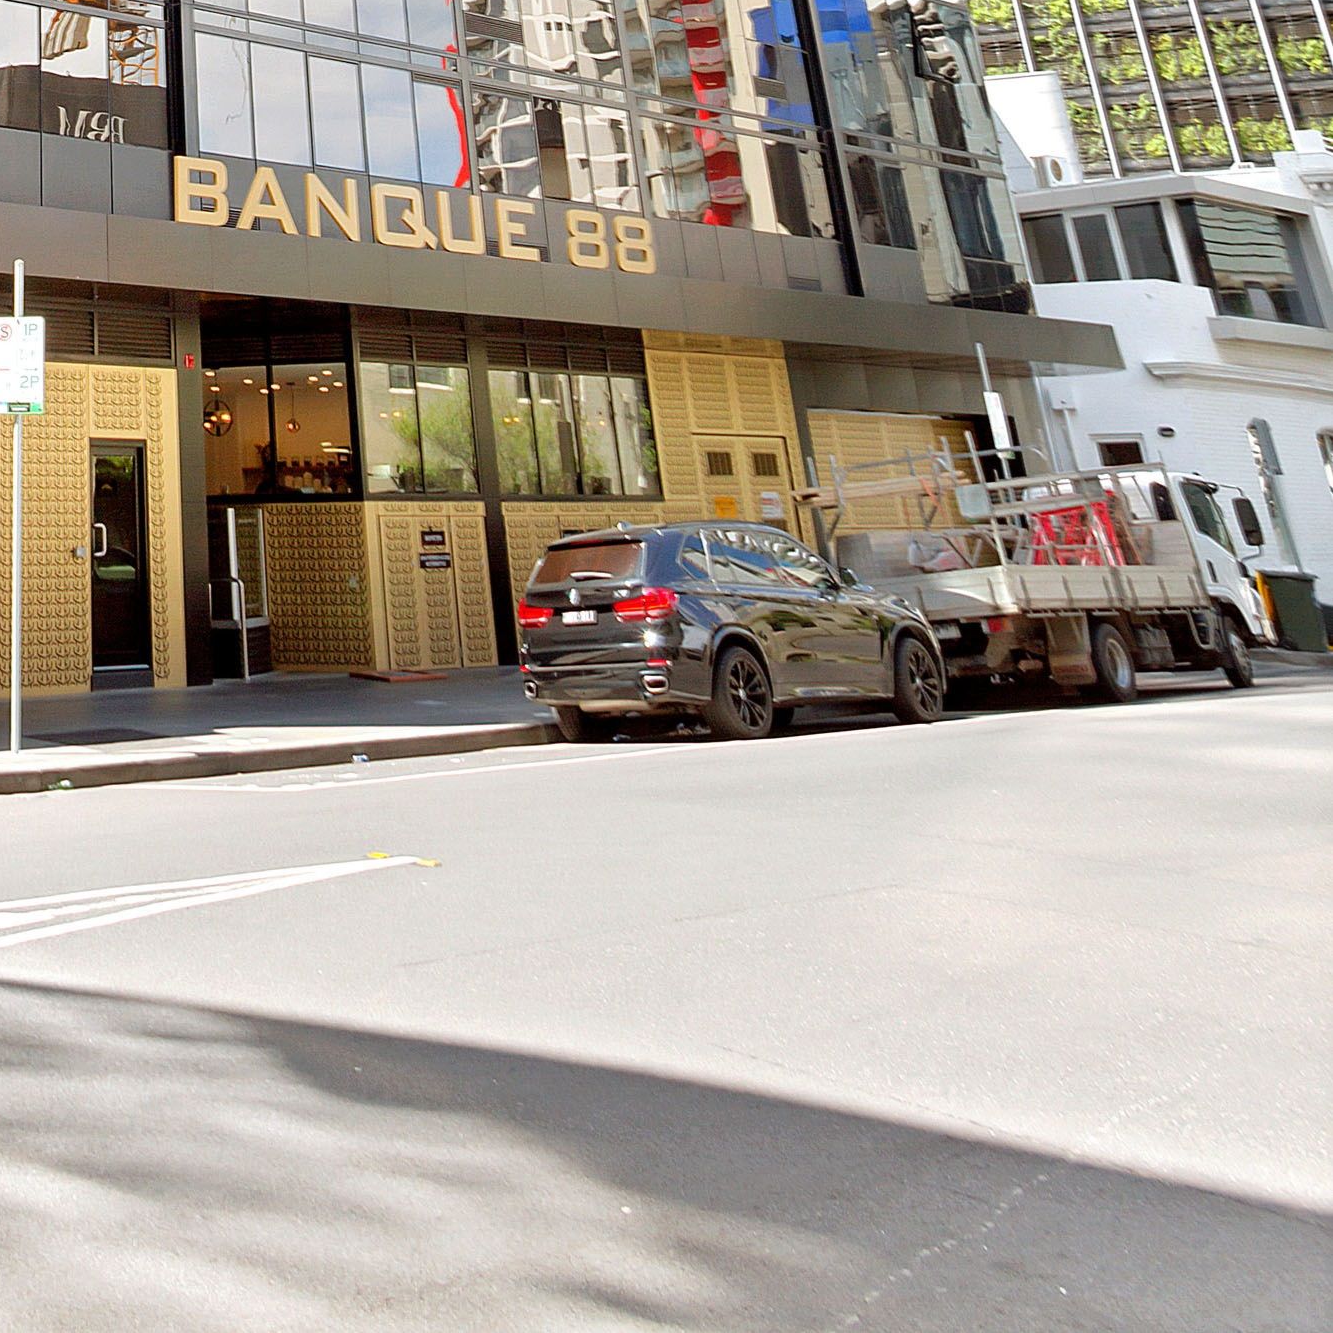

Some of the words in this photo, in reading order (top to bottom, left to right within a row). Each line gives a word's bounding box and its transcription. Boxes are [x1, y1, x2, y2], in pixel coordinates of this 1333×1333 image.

[174, 155, 541, 262] BANQUE
[567, 208, 657, 274] 88
[24, 323, 38, 336] 1P
[19, 375, 40, 389] 2P
